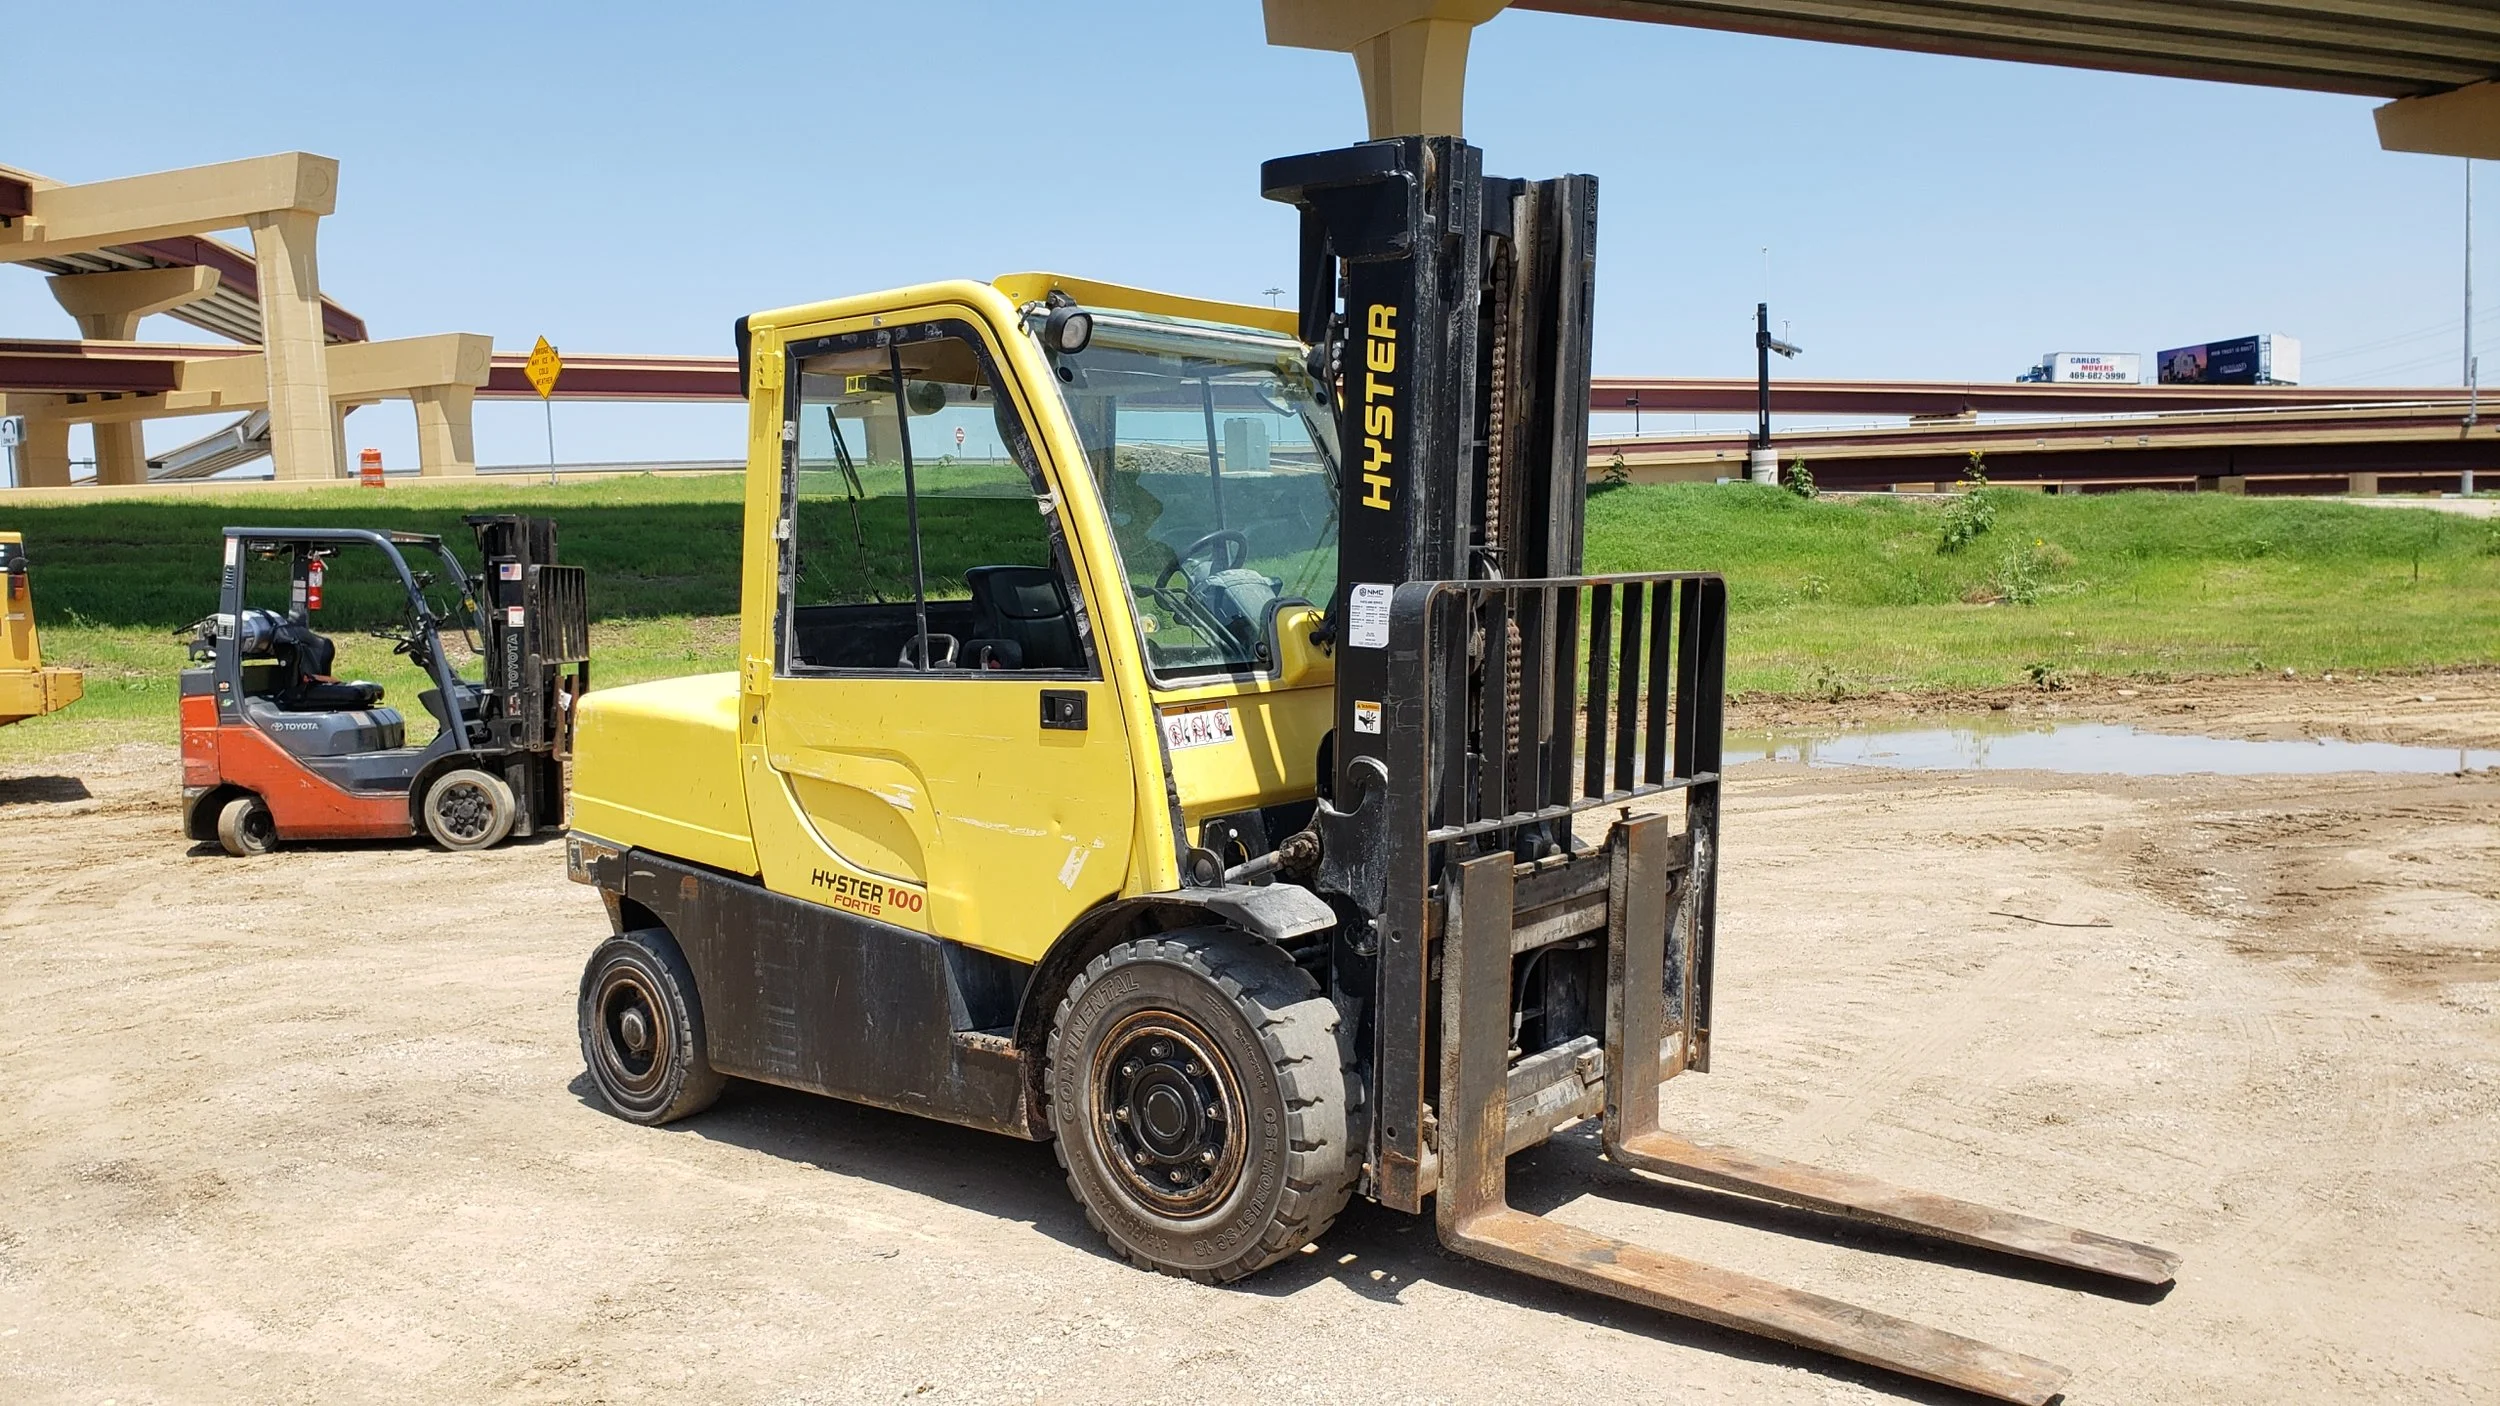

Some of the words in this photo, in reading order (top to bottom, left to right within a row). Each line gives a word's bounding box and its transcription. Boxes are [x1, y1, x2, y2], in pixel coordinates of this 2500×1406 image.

[1362, 303, 1397, 511] HYSTER
[507, 633, 519, 690] TOYOTA
[284, 722, 319, 730] TOYOTA
[811, 868, 884, 903] HYSTER
[888, 887, 923, 913] 100
[833, 894, 882, 916] FORTIS
[1060, 971, 1139, 1121] CONTINENTAL
